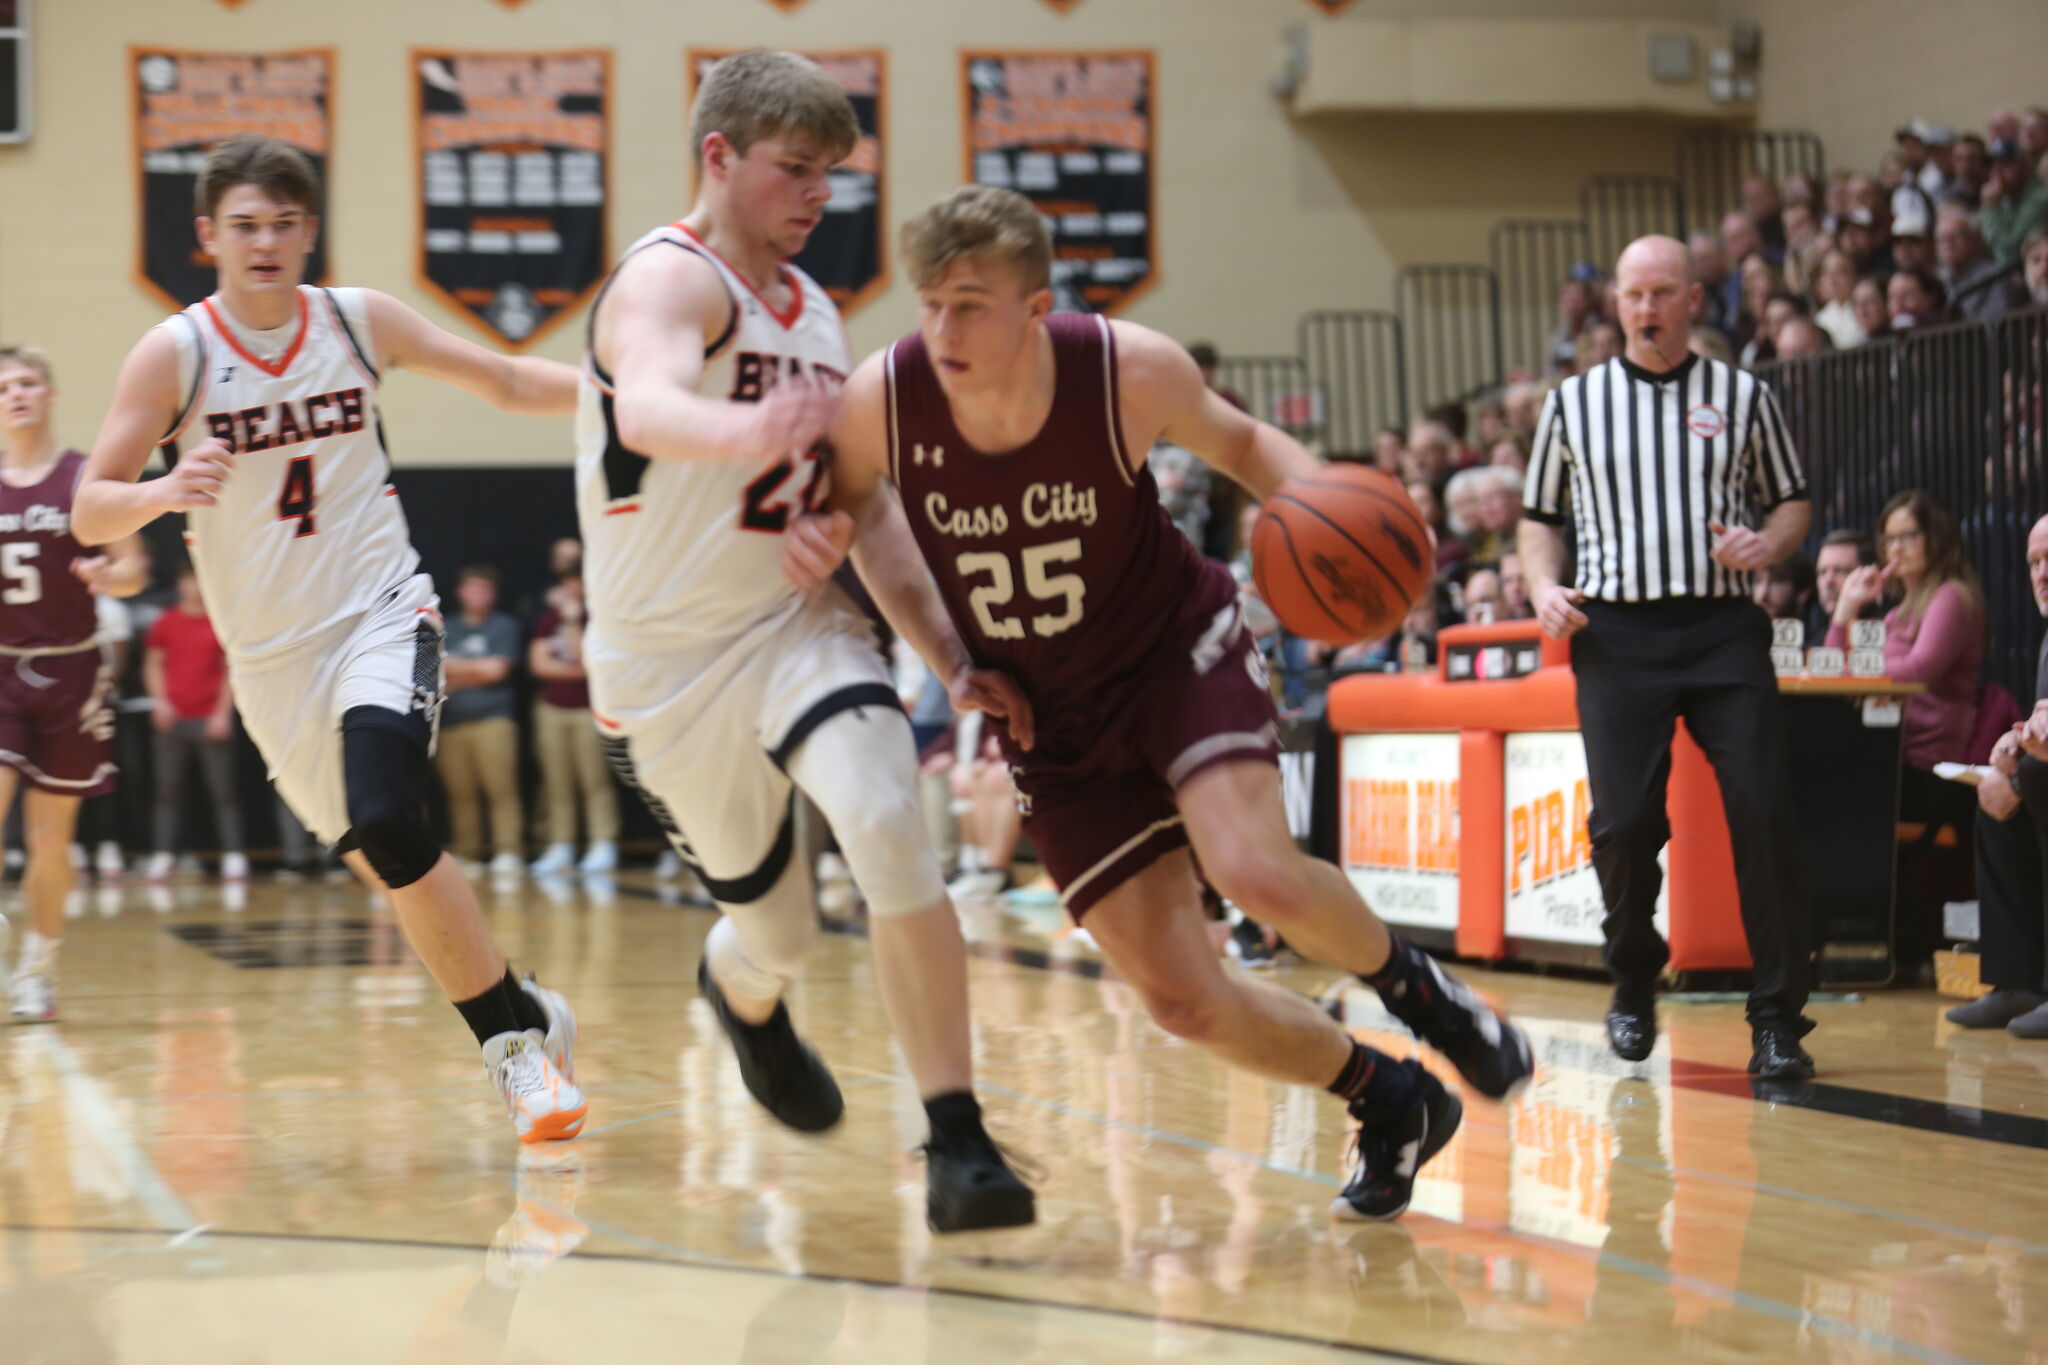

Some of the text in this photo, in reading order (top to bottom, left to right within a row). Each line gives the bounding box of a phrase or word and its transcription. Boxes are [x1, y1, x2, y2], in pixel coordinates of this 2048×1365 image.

[207, 386, 365, 456] BEACH
[277, 454, 318, 538] 4
[925, 481, 1098, 538] Cass City
[0, 541, 42, 605] 5
[956, 537, 1086, 640] 25
[1510, 776, 1594, 897] PIRA
